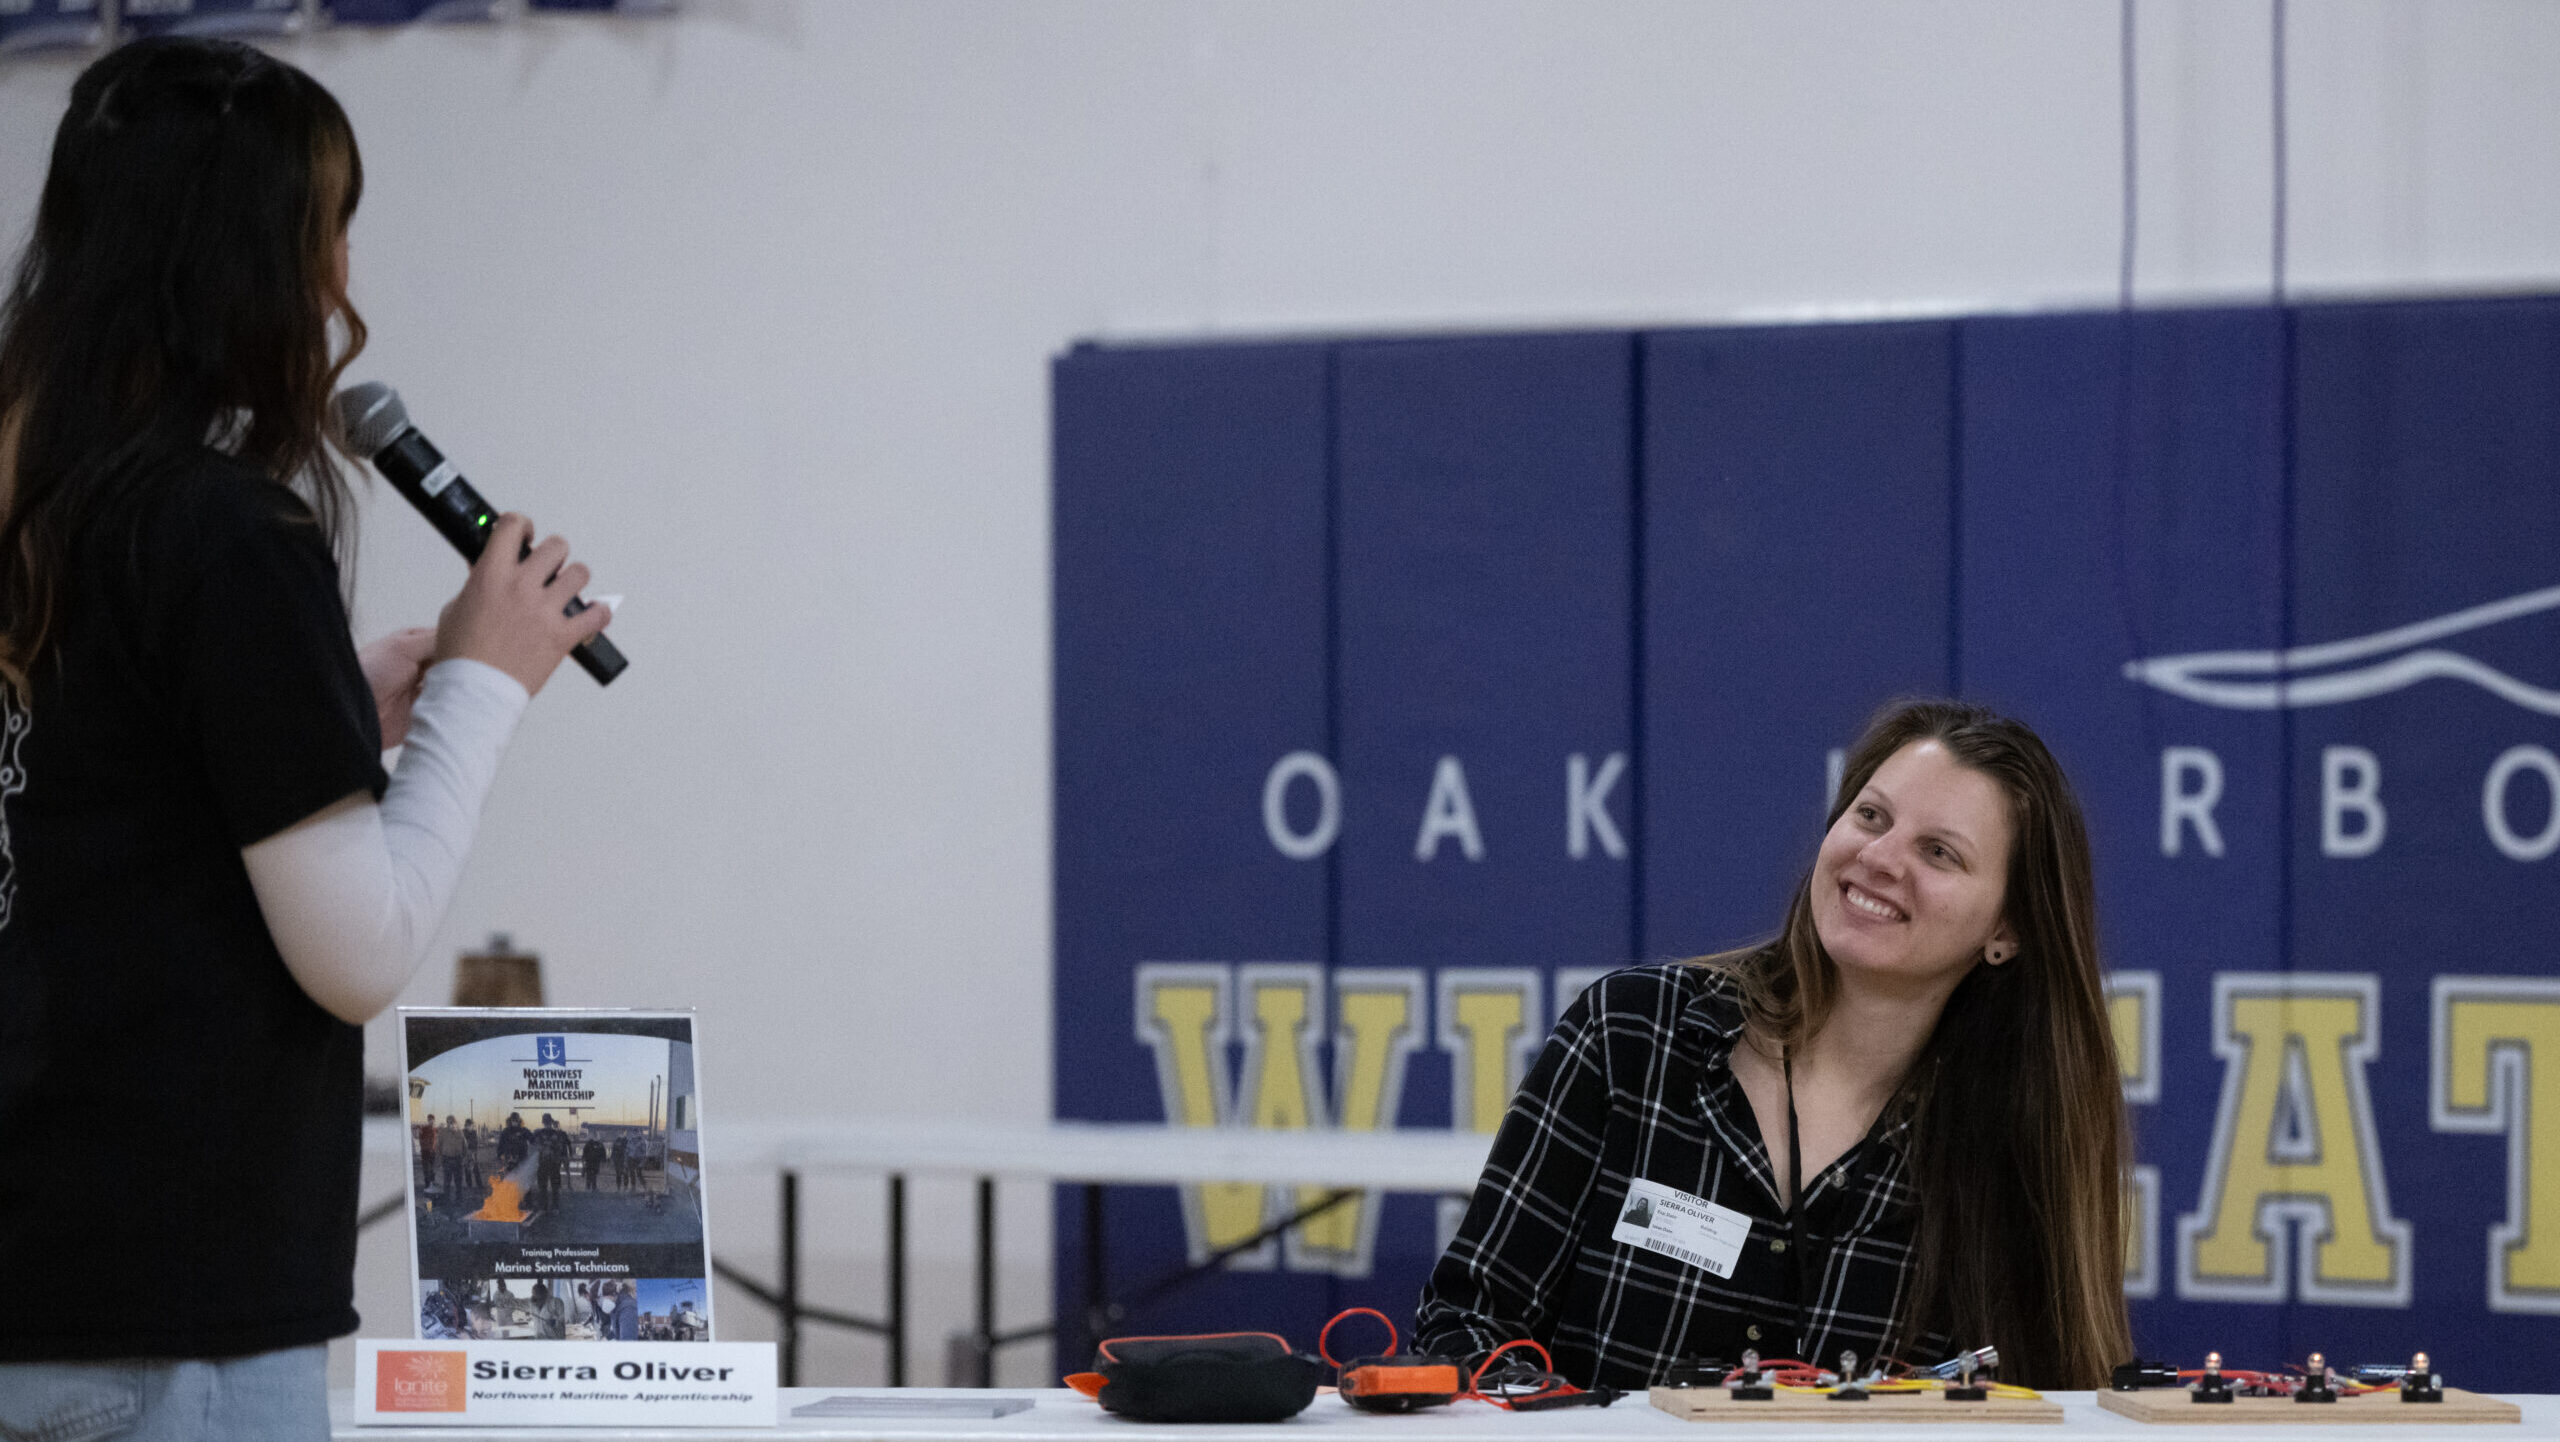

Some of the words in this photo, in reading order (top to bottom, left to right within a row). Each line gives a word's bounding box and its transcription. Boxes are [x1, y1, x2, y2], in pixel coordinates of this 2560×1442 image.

[1261, 751, 1629, 862] OAK
[523, 1068, 583, 1079] NORTHWEST
[527, 1079, 579, 1090] MARITIME
[513, 1089, 595, 1100] APPRENTICESHIP
[1674, 1190, 1709, 1209] VISITOR
[1659, 1199, 1686, 1214] SIERRA
[1687, 1208, 1715, 1224] OLIVER
[521, 1248, 553, 1259] Training
[554, 1247, 599, 1257] Professional
[495, 1261, 532, 1273] Marine
[535, 1261, 571, 1273] Service
[574, 1260, 630, 1273] Technicans
[472, 1360, 598, 1380] Sierra
[613, 1361, 734, 1381] Oliver
[394, 1377, 448, 1396] Ignite
[472, 1391, 555, 1400] Northwest
[560, 1391, 629, 1401] Maritime
[633, 1392, 753, 1403] Apprenticeship
